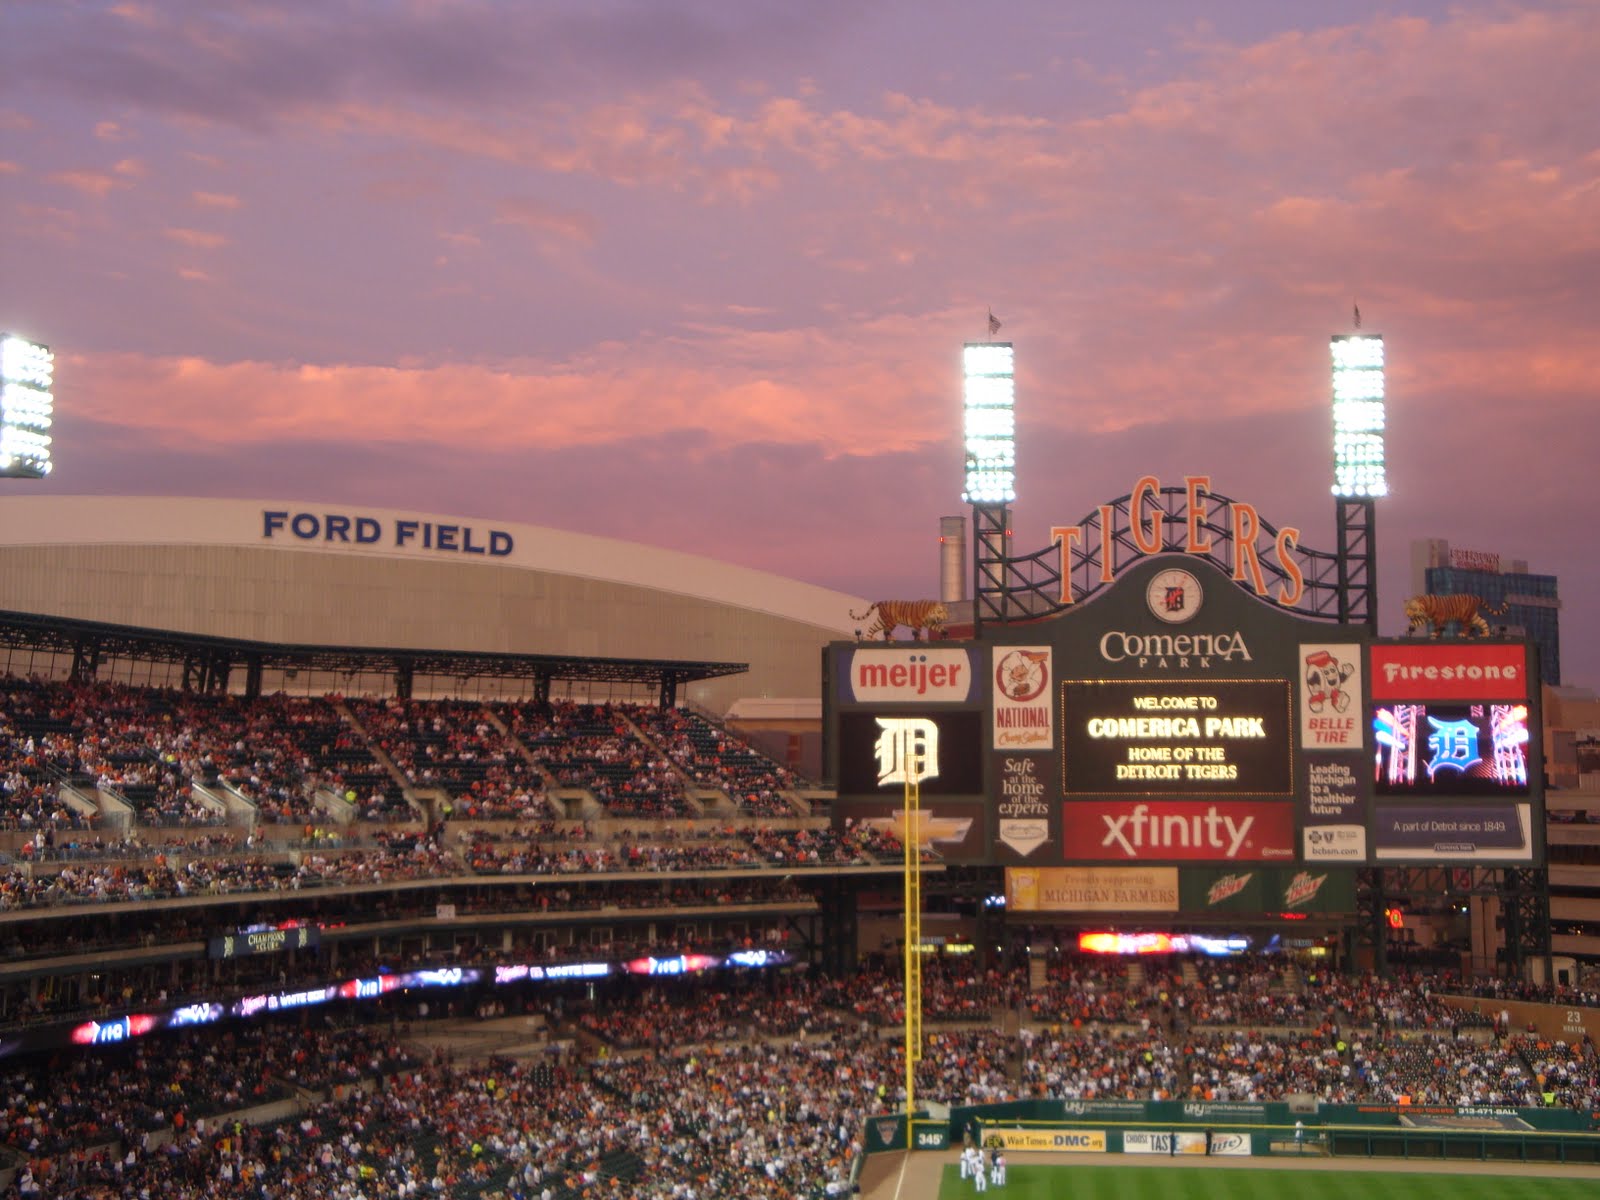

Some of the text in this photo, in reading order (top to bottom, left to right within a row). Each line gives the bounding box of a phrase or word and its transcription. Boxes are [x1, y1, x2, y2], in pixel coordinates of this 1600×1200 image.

[262, 510, 515, 557] FORD FIELD
[1051, 475, 1304, 606] TIGERS
[1138, 657, 1211, 669] PARK
[859, 654, 962, 695] meijer
[1382, 662, 1518, 684] Firestone
[1133, 696, 1218, 711] WELCOME TO
[996, 706, 1050, 729] NATIONAL
[1308, 717, 1355, 731] BELLE
[1087, 716, 1266, 739] COMERICA PARK
[1314, 731, 1349, 744] TIRE
[1127, 747, 1226, 762] HOME OF THE
[1004, 758, 1036, 776] Safe
[1115, 764, 1238, 781] DETROIT TIGERS
[1309, 763, 1351, 777] Leading
[1002, 779, 1045, 795] home
[1009, 774, 1038, 785] at the
[1309, 774, 1357, 787] Michigan
[1309, 784, 1330, 794] to a
[1011, 794, 1040, 804] of the
[1309, 792, 1356, 804] healthier
[998, 802, 1049, 818] experts
[1309, 804, 1342, 815] future
[1101, 804, 1255, 857] xfinity
[1393, 820, 1401, 831] A
[1402, 821, 1420, 833] part
[1420, 820, 1430, 832] of
[1431, 820, 1458, 832] Detroit
[1459, 820, 1481, 832] since
[1312, 846, 1359, 856] bcbsm.com
[1044, 888, 1177, 904] MICHIGAN FARMERS
[247, 930, 286, 947] CHAMPIONS
[1566, 1010, 1582, 1023] 23
[1007, 1135, 1025, 1146] Wait
[1026, 1136, 1048, 1146] Times
[1125, 1133, 1181, 1152] CHOOSE TASE
